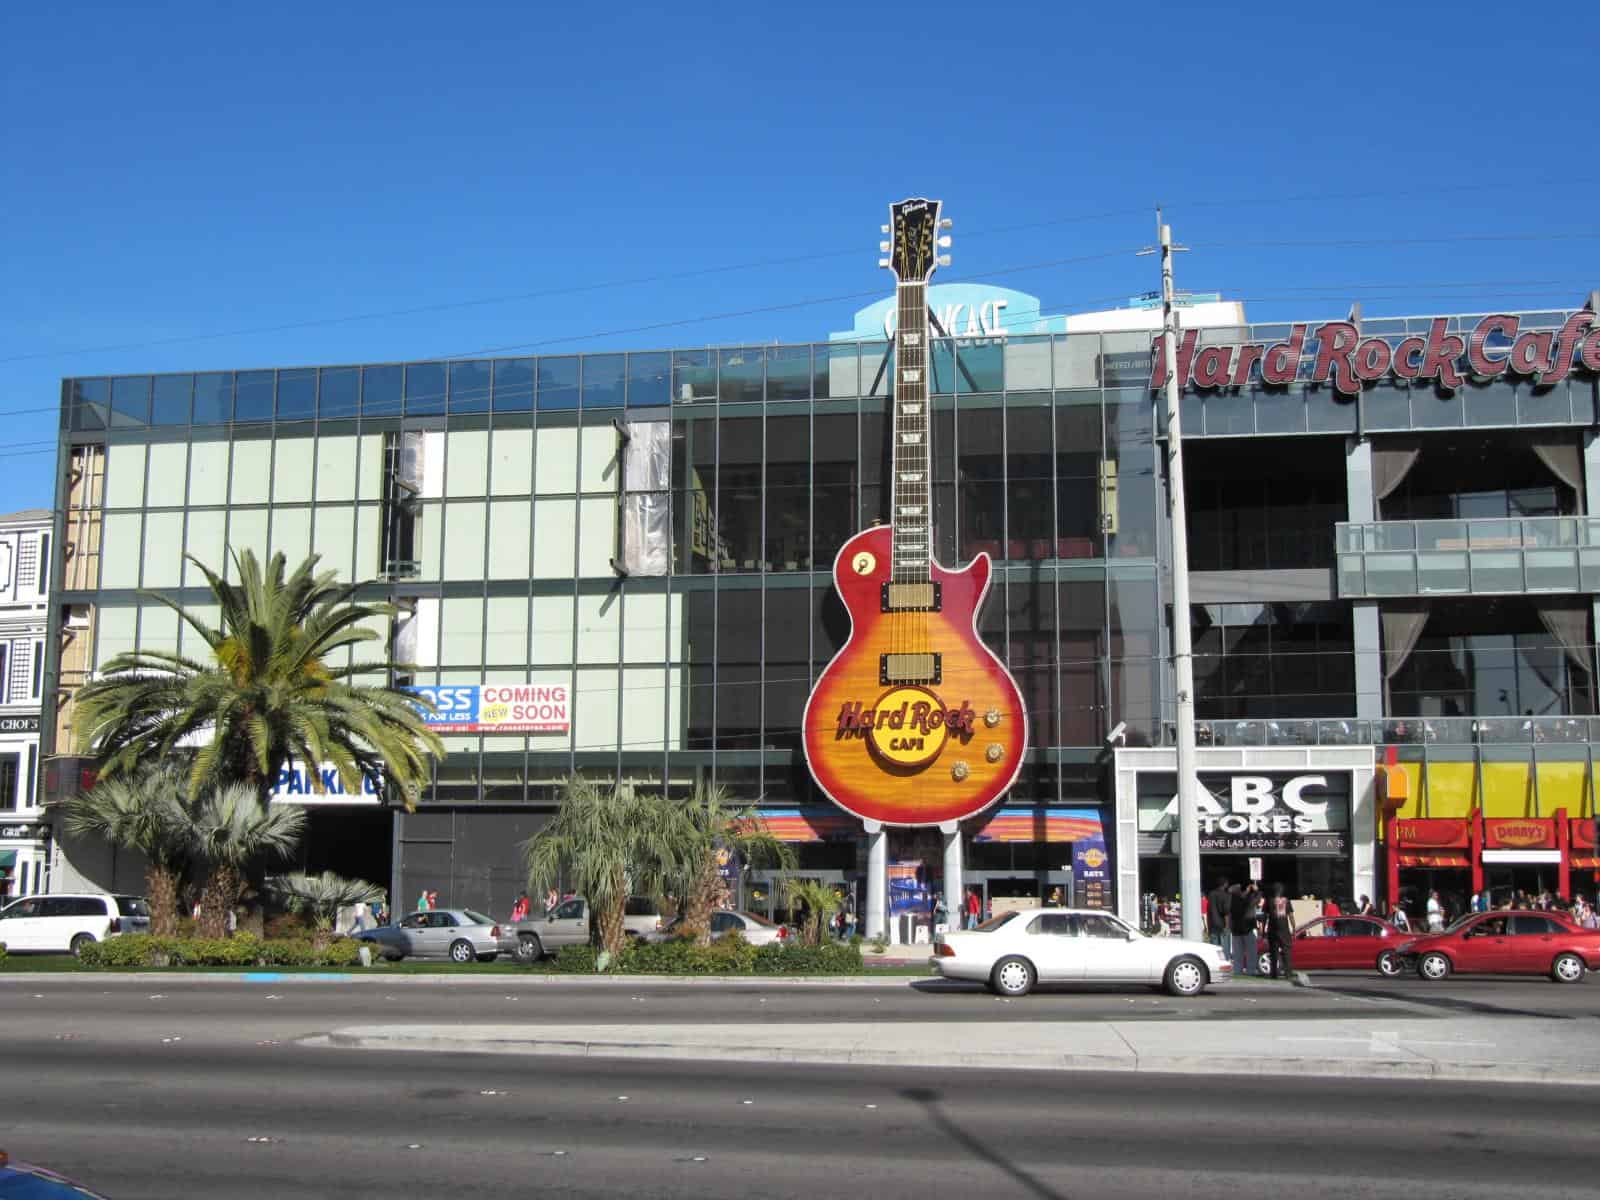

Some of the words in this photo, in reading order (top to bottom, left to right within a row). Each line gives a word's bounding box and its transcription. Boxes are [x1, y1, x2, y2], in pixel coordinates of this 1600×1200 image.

[1149, 323, 1307, 391] Hard
[1311, 320, 1466, 395] Rock
[414, 688, 472, 711] OSS
[484, 687, 566, 703] COMING
[512, 705, 566, 721] SOON
[838, 701, 906, 731] Hard
[910, 701, 976, 735] Rock
[889, 738, 925, 751] CAFE
[274, 768, 382, 795] PAKIG
[1165, 775, 1329, 816] ABC
[1197, 815, 1313, 834] TORES
[1227, 838, 1243, 848] LAS
